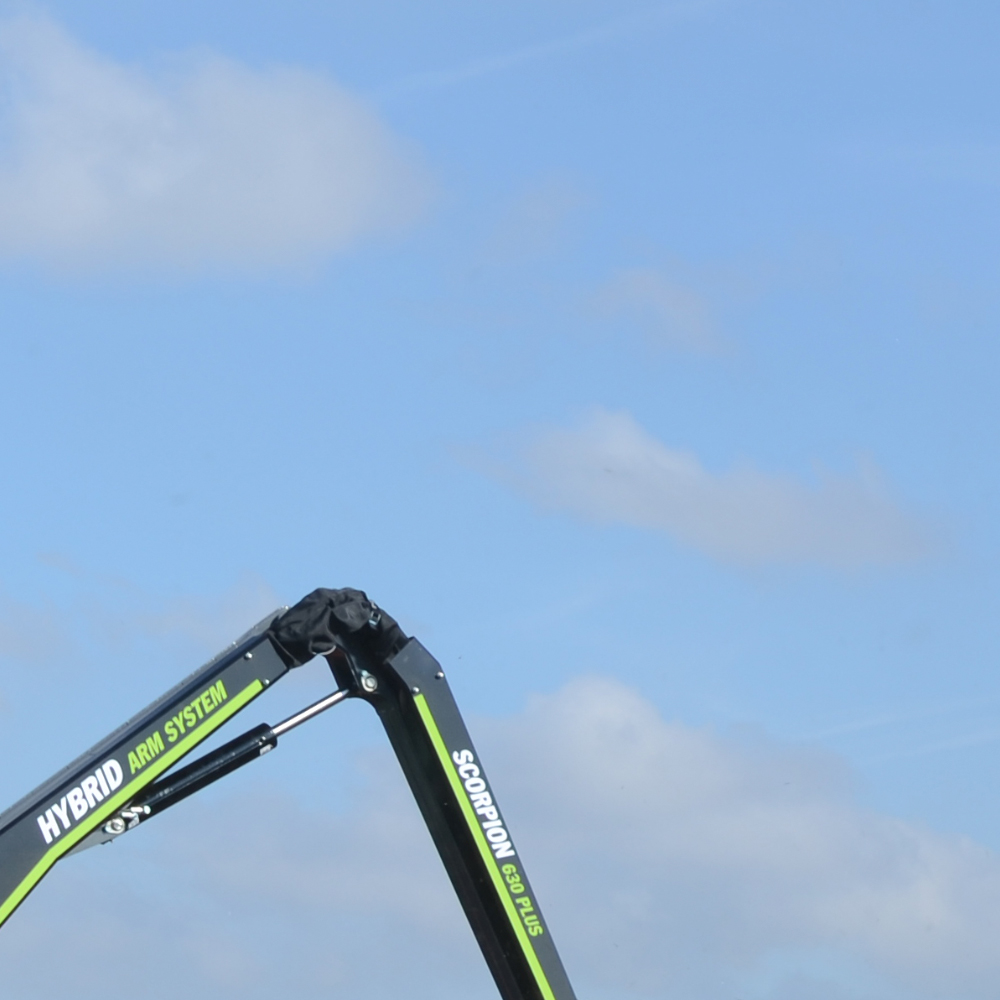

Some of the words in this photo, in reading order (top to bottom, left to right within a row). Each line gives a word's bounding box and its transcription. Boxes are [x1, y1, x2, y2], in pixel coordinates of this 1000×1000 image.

[36, 758, 124, 844] HYBRID
[127, 730, 165, 775] ARM
[164, 679, 228, 743] SYSTEM
[452, 749, 516, 859] SCORPION
[501, 863, 525, 894] 630
[515, 896, 544, 937] PLUS
